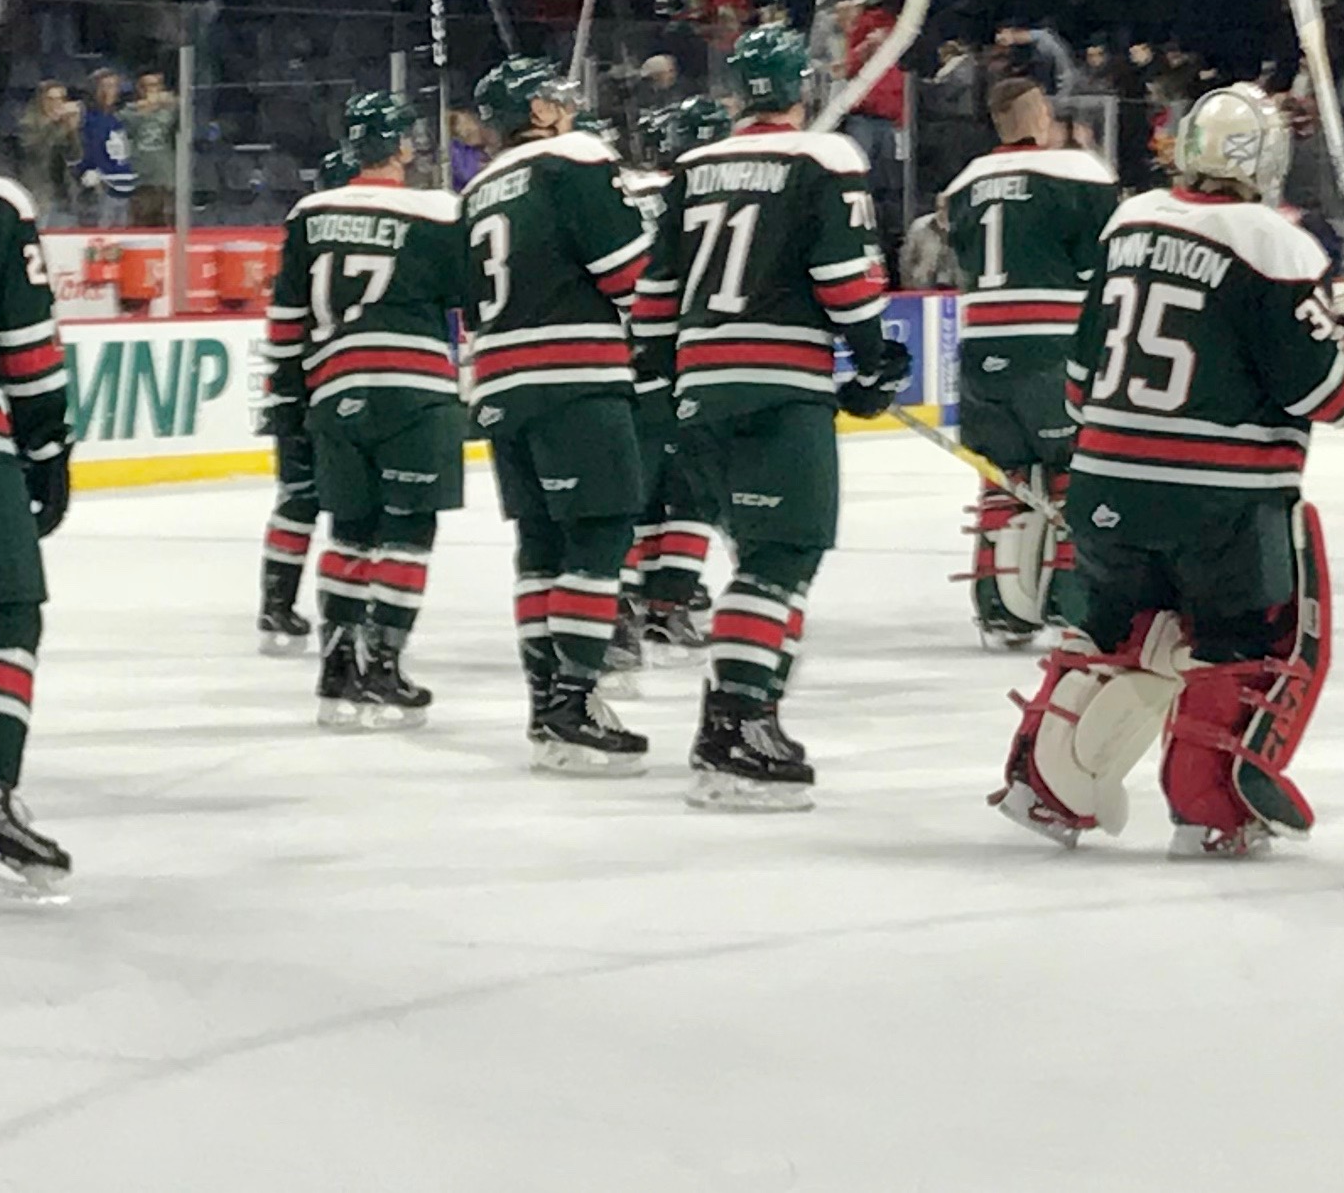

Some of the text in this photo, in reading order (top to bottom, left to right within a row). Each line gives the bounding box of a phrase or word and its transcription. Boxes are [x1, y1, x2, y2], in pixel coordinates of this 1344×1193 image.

[308, 252, 396, 342] 17
[470, 213, 510, 323] 3
[680, 201, 760, 314] 71
[978, 203, 1008, 288] 1
[64, 337, 229, 442] MNP
[1092, 276, 1205, 411] 35
